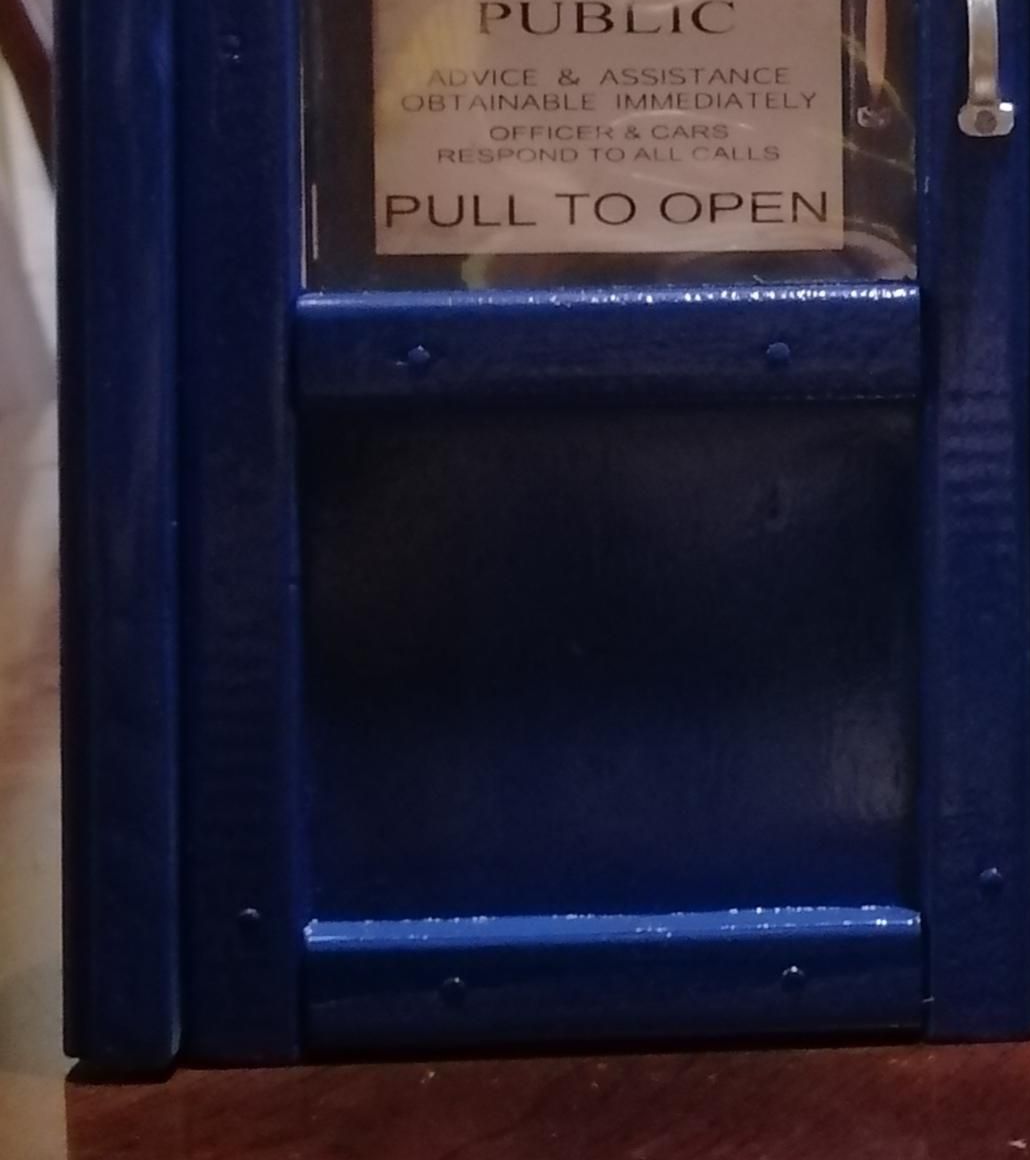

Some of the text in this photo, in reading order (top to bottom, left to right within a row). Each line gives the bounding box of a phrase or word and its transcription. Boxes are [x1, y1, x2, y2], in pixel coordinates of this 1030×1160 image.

[478, 1, 737, 35] PUBLIC
[428, 67, 790, 87] ADVICE & ASSISTANCE
[402, 92, 817, 112] OBTAINABLE IMMEDIATELY
[489, 124, 728, 141] OFFICER & CARS
[437, 146, 780, 164] RESPOND TO ALL CALLS
[386, 191, 827, 227] PULL TO OPEN
